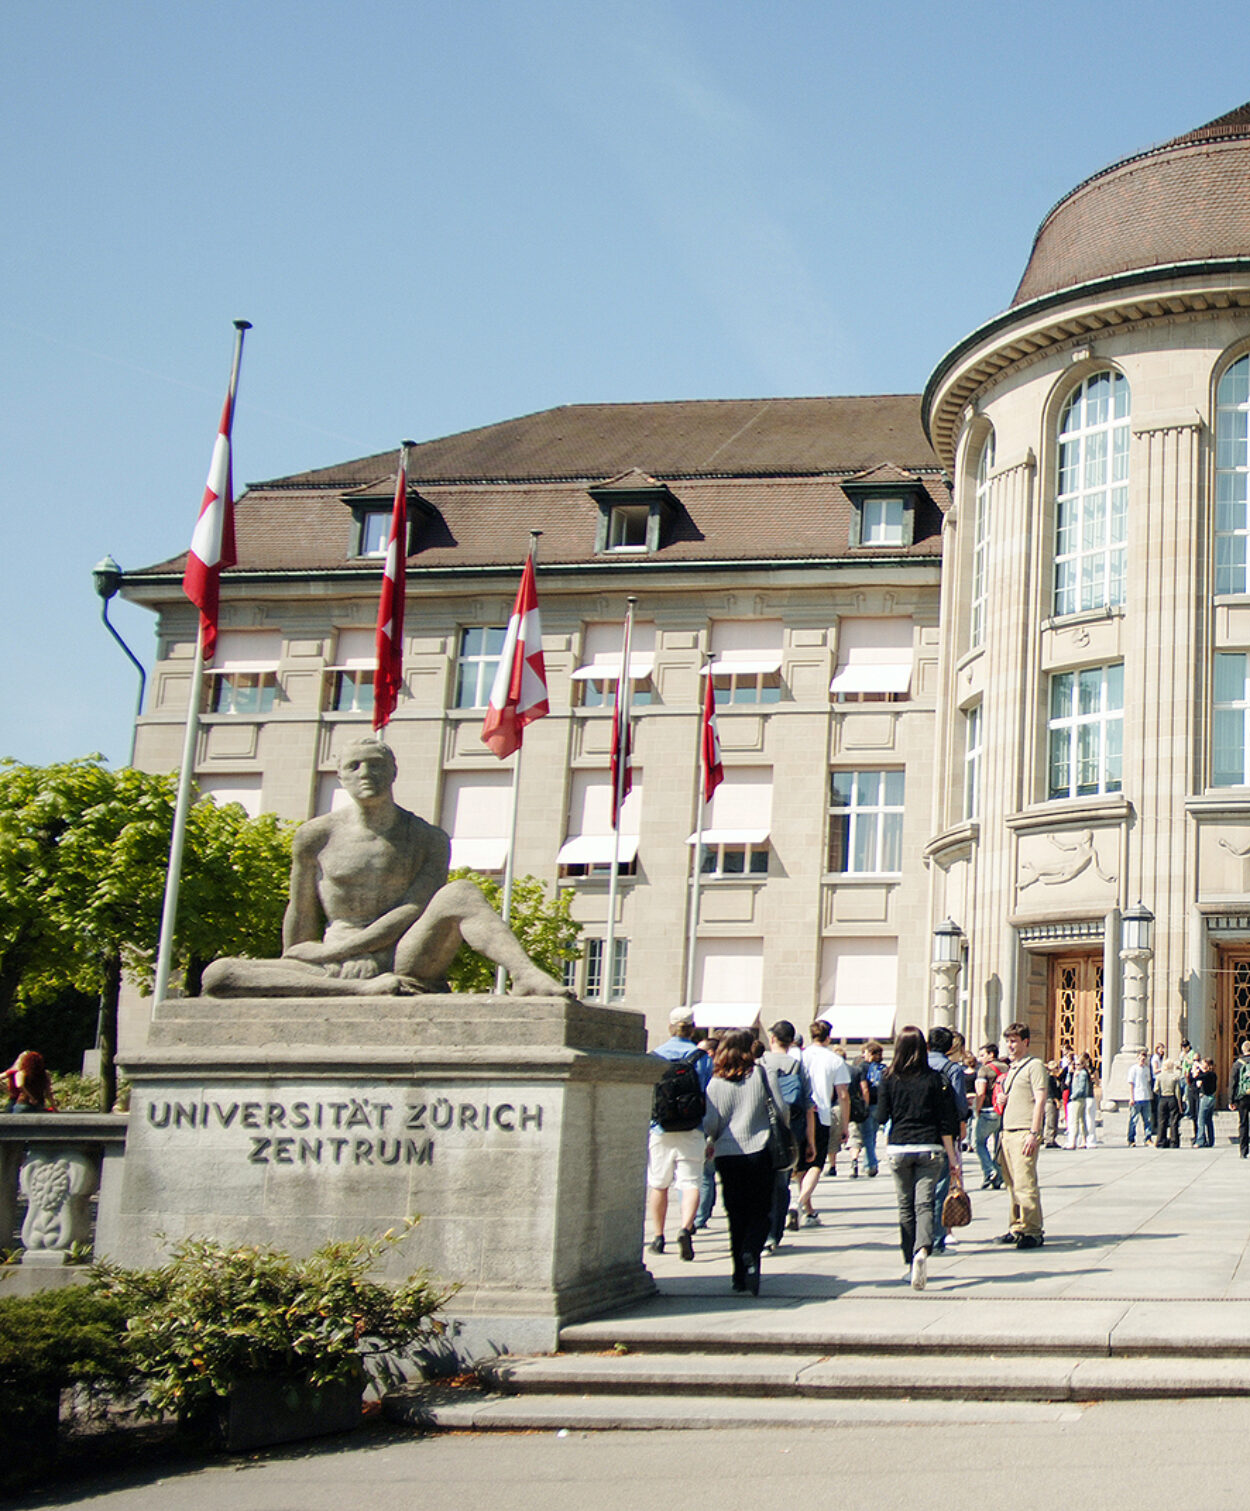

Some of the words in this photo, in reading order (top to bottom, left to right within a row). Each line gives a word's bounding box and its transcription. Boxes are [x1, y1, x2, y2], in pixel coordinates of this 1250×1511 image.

[147, 1098, 393, 1129] UNIVERSITÄT
[405, 1098, 543, 1131] ZÜRICH
[248, 1136, 435, 1165] ZENTRUM
